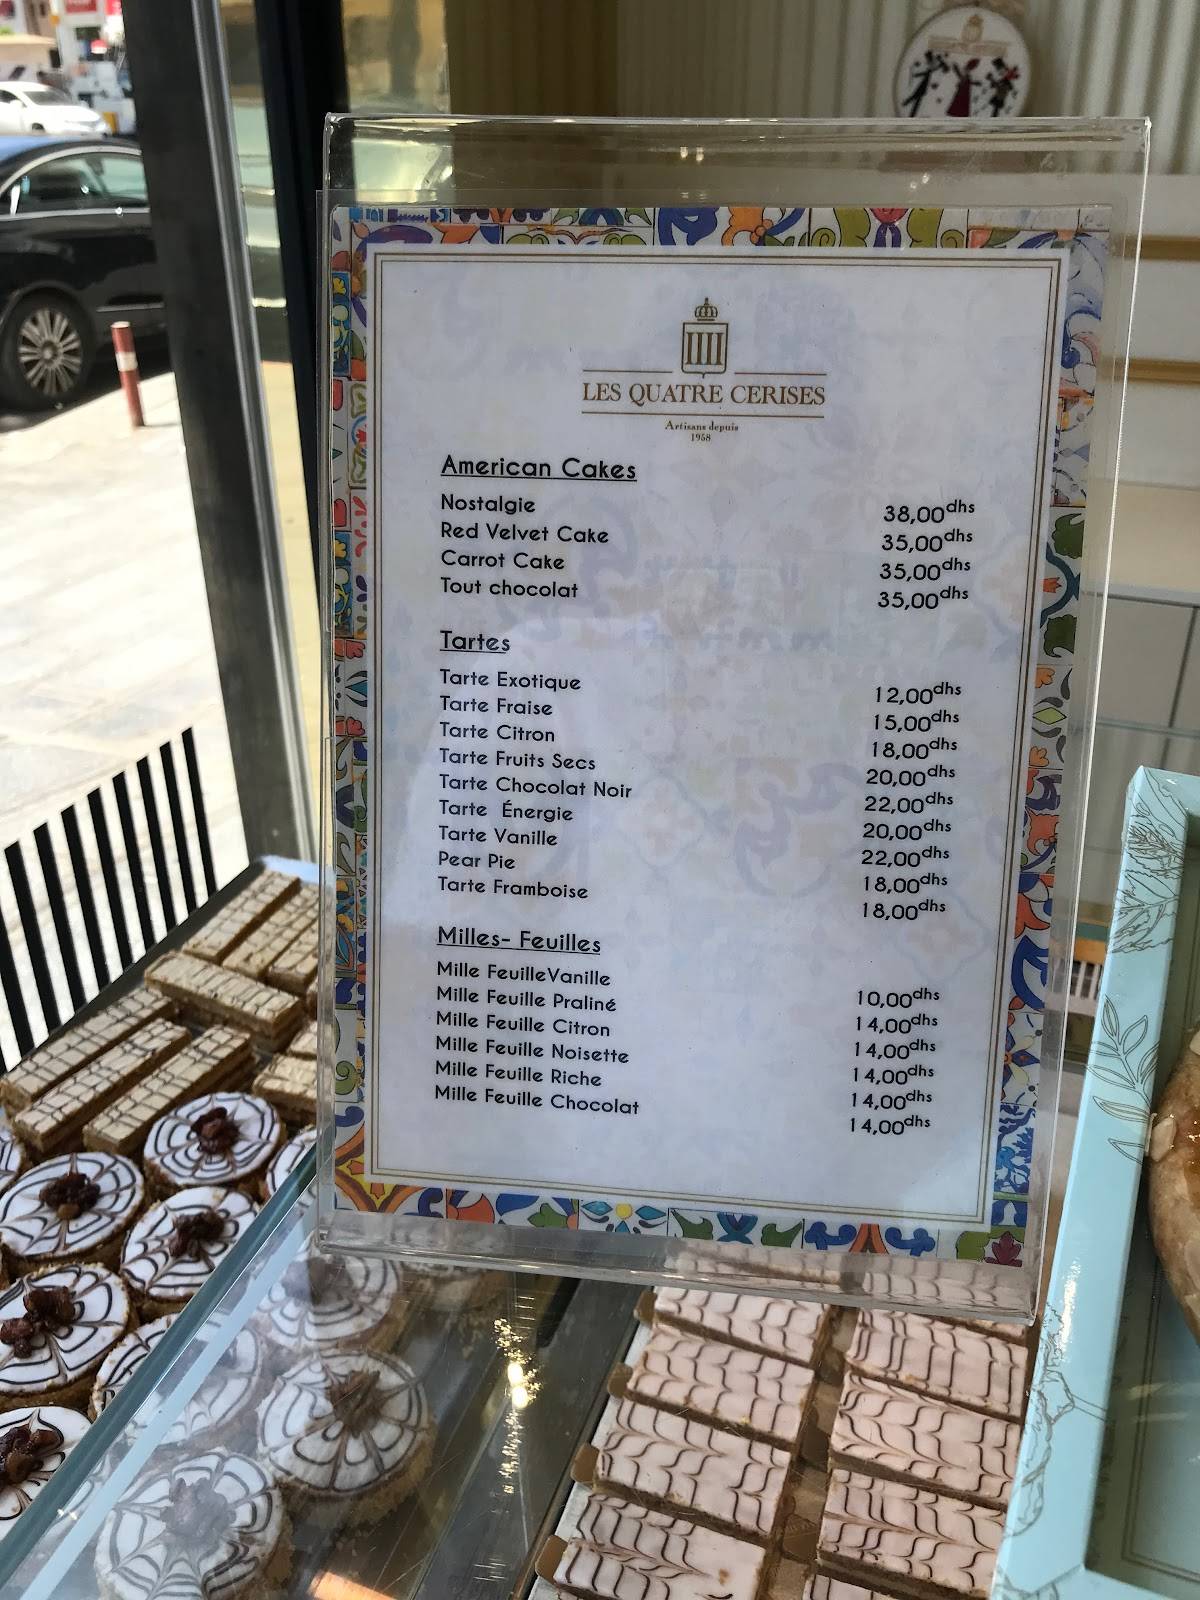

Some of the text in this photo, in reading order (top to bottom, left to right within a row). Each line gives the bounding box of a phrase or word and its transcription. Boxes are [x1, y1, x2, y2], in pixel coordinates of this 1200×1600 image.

[583, 382, 826, 407] LES QUATRE CERISES
[665, 420, 739, 433] Artisans depuis
[441, 454, 637, 480] American Cakes
[441, 493, 535, 515] Nostalgie
[441, 521, 478, 539] Red
[486, 523, 549, 541] Velvet
[557, 525, 608, 543] Cake
[441, 549, 505, 568] Carrot
[513, 552, 565, 570] Cake
[441, 577, 481, 594] Tout
[489, 579, 578, 599] chocolat
[440, 630, 510, 652] Tartes
[440, 669, 489, 686] Tarte
[498, 671, 581, 692] Exotique
[440, 695, 489, 712] Tarte
[497, 698, 552, 715] Fraise
[440, 722, 488, 739] Tarte
[497, 724, 554, 742] Citron
[440, 748, 488, 765] Tarte
[496, 751, 544, 767] Fruits
[552, 753, 595, 770] Secs
[439, 774, 487, 790] Tarte
[496, 777, 586, 795] Chocolat
[594, 782, 632, 798] Noir
[439, 800, 487, 816] Tarte
[502, 800, 573, 822] Énergie
[439, 825, 487, 842] Tarte
[494, 828, 557, 846] Vanille
[438, 851, 481, 867] Pear
[488, 853, 515, 869] Pie
[438, 876, 485, 893] Tarte
[494, 879, 588, 899] Framboise
[519, 931, 601, 953] Feuilles
[437, 961, 479, 978] Mille
[437, 986, 479, 1003] Mille
[487, 989, 546, 1007] Feuille
[553, 993, 616, 1012] Praliné
[437, 1011, 478, 1028] Mille
[487, 1014, 544, 1032] Feuille
[553, 1019, 610, 1036] Citron
[436, 1035, 478, 1052] Mille
[486, 1039, 544, 1057] Feuille
[552, 1044, 629, 1064] Noisette
[436, 1060, 477, 1077] Mille
[486, 1064, 543, 1082] Feuille
[551, 1069, 602, 1087] Riche
[435, 1085, 477, 1102] Mille
[485, 1088, 543, 1107] Feuille
[551, 1094, 639, 1114] Chocolat
